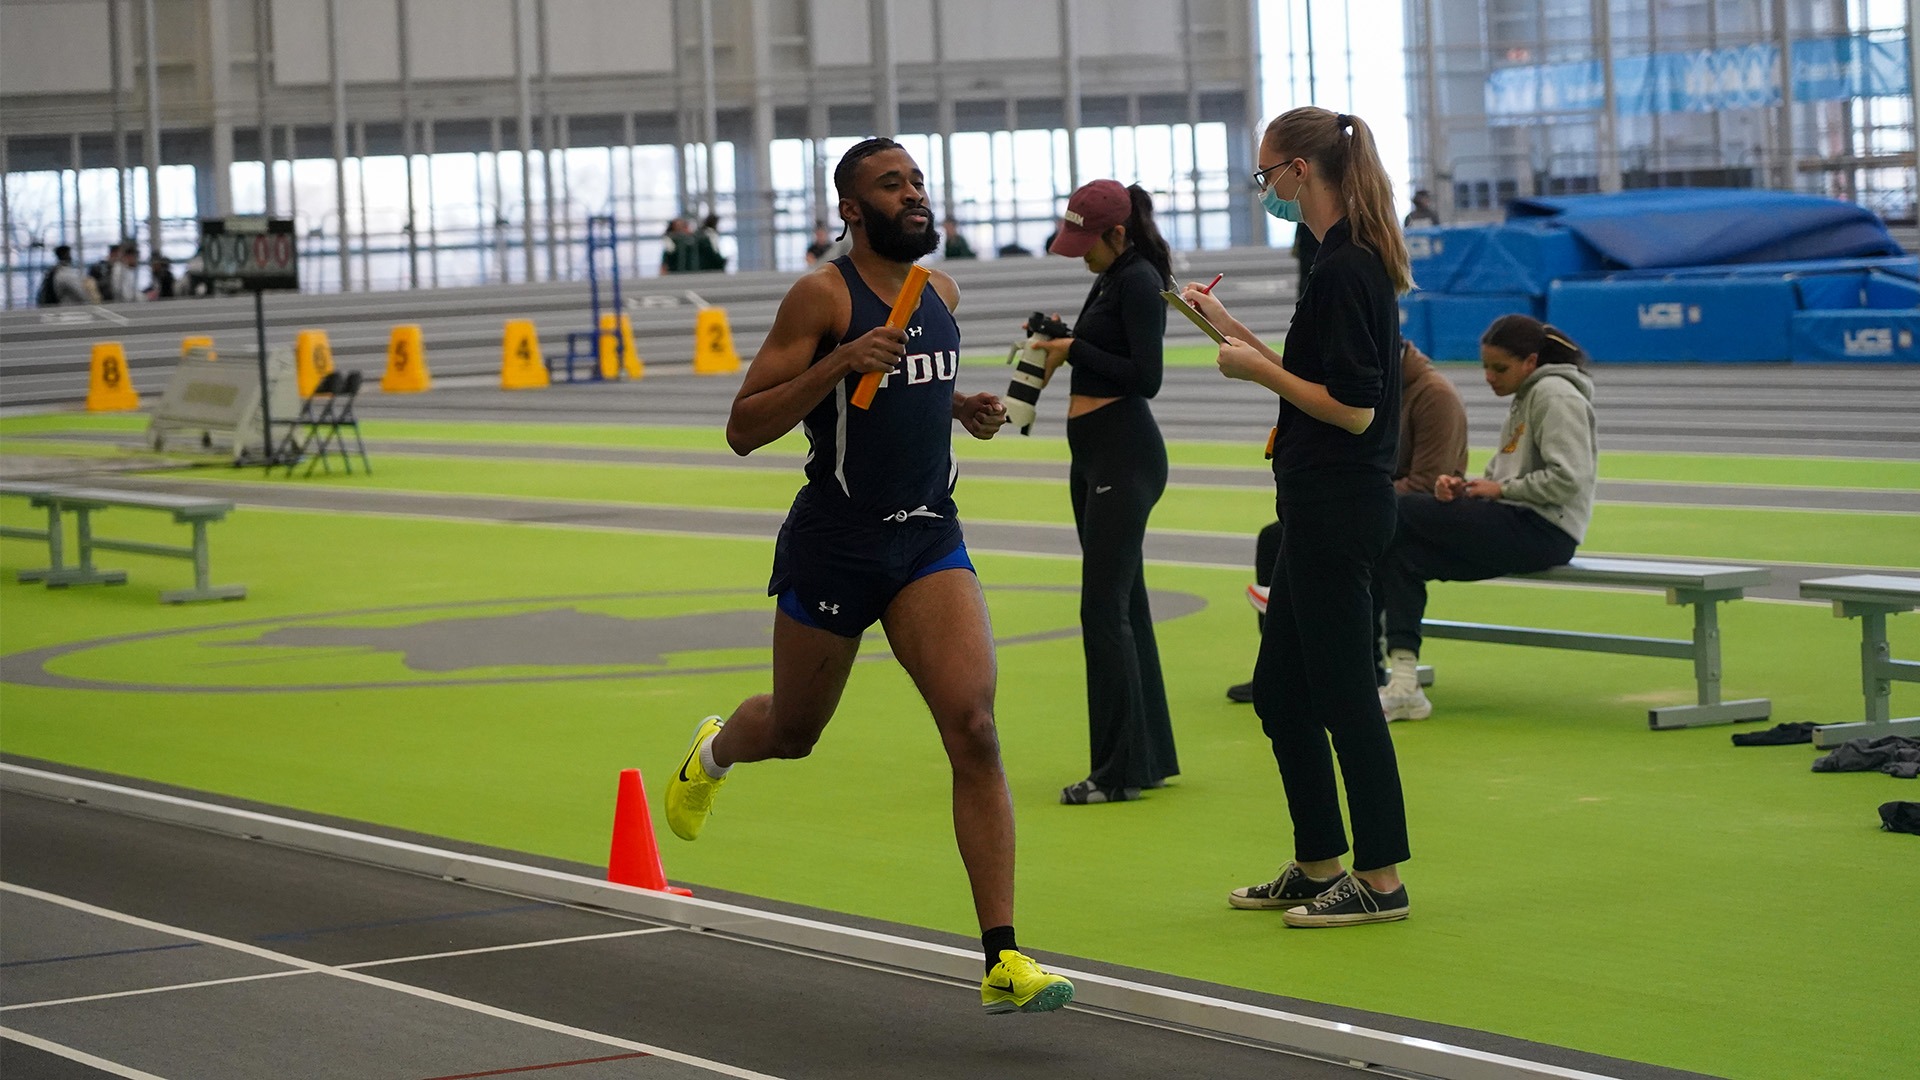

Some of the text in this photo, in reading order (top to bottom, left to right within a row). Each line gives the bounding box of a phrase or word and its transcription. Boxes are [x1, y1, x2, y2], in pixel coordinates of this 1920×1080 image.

[516, 336, 531, 361] 4
[709, 323, 724, 353] 2
[102, 355, 120, 388] 8
[394, 340, 409, 372] 5
